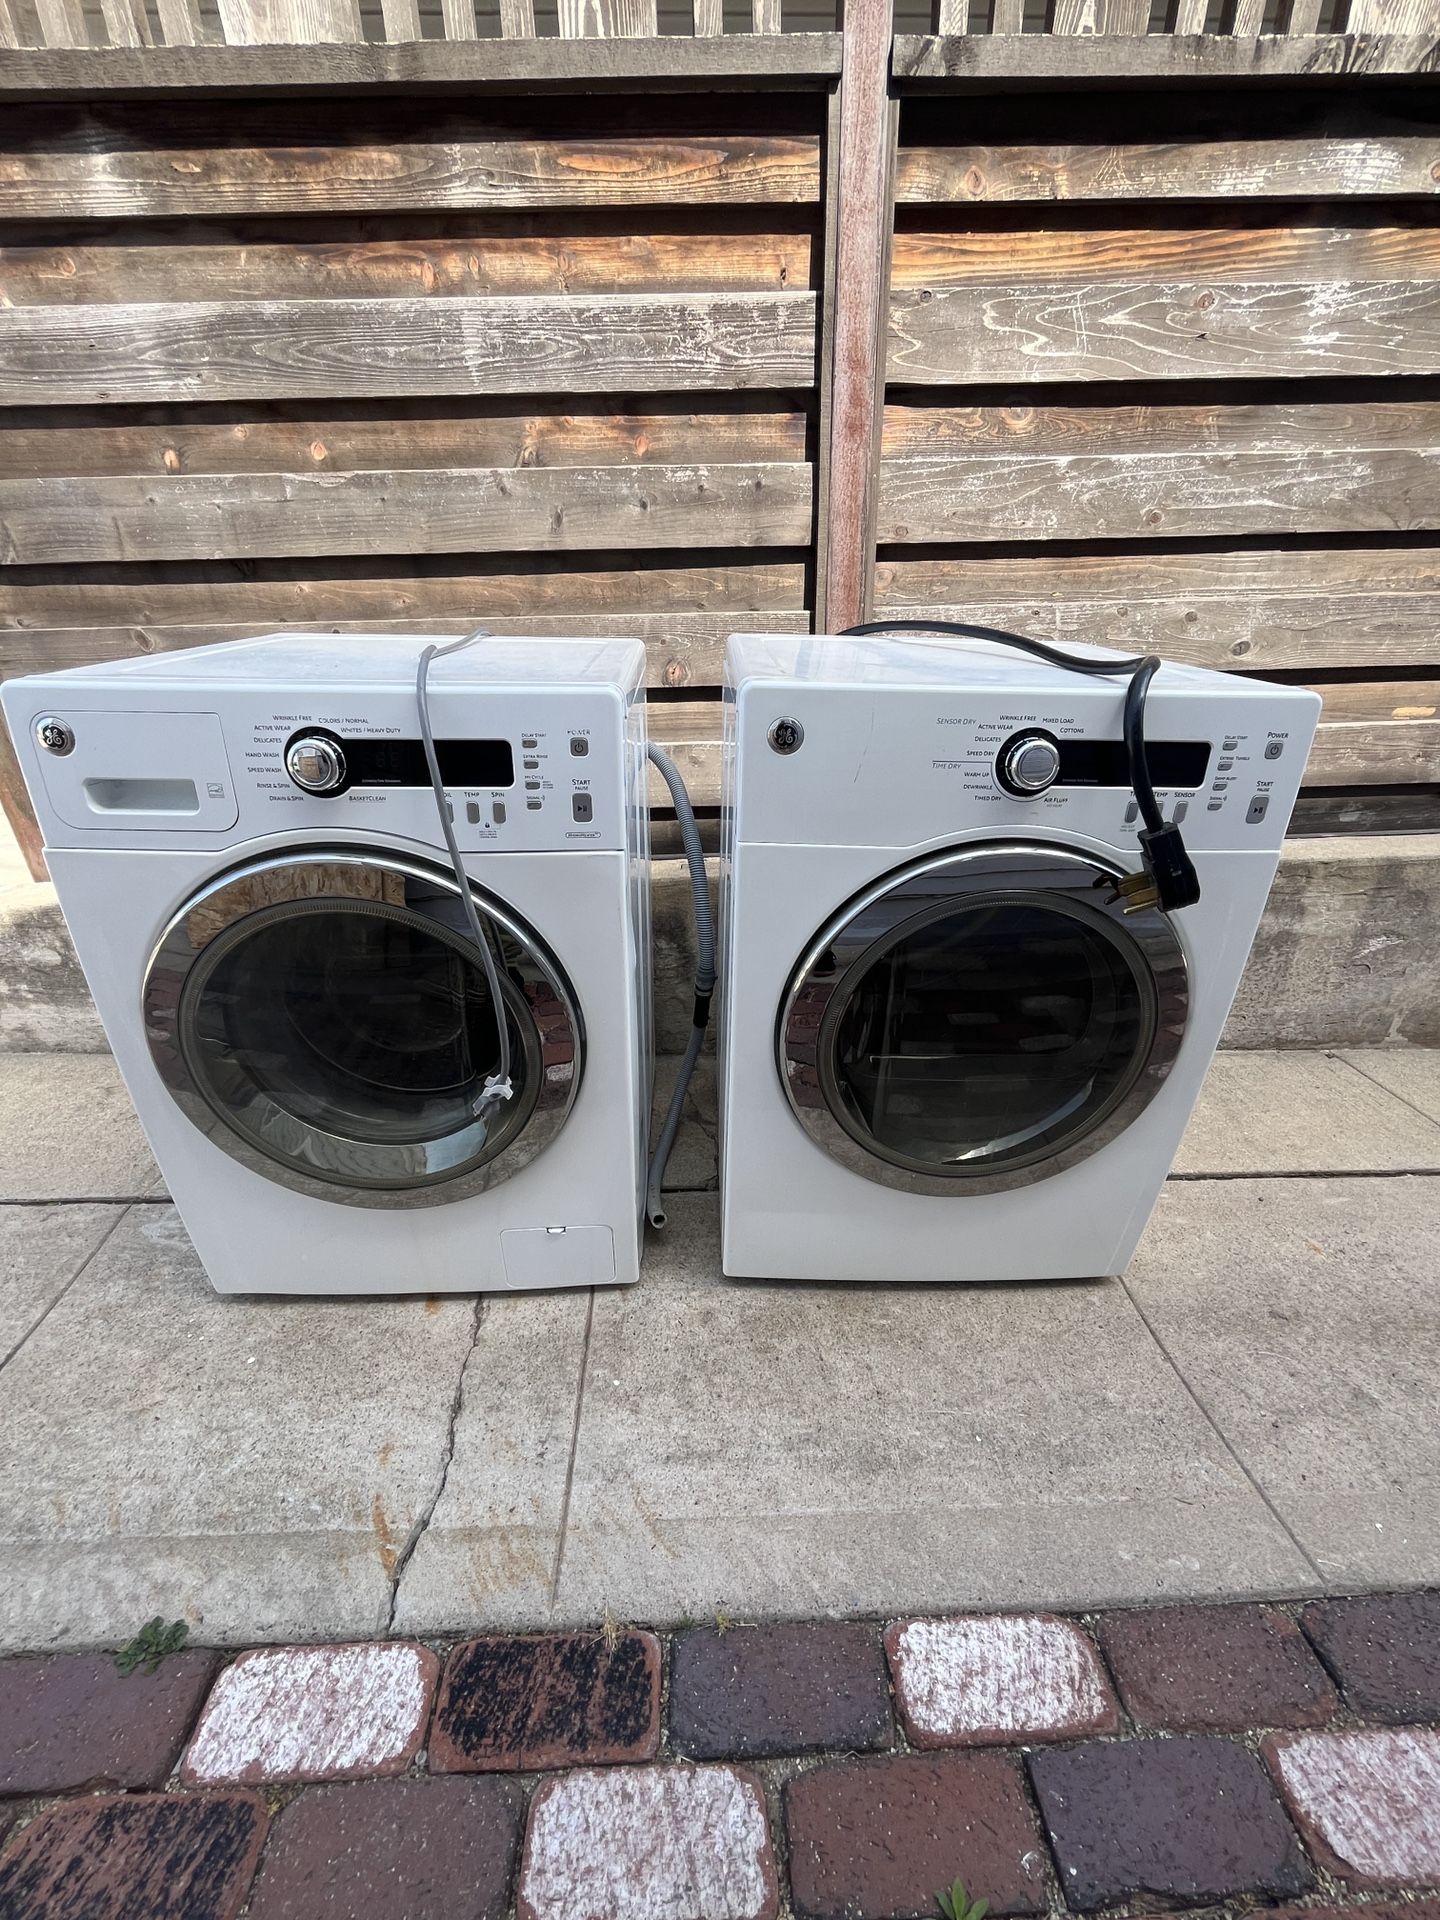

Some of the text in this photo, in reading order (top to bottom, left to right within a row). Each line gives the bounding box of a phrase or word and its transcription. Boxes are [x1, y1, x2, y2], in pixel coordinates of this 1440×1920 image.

[936, 717, 962, 725] SENSOR
[1267, 731, 1289, 739] POWER
[572, 778, 591, 786] START
